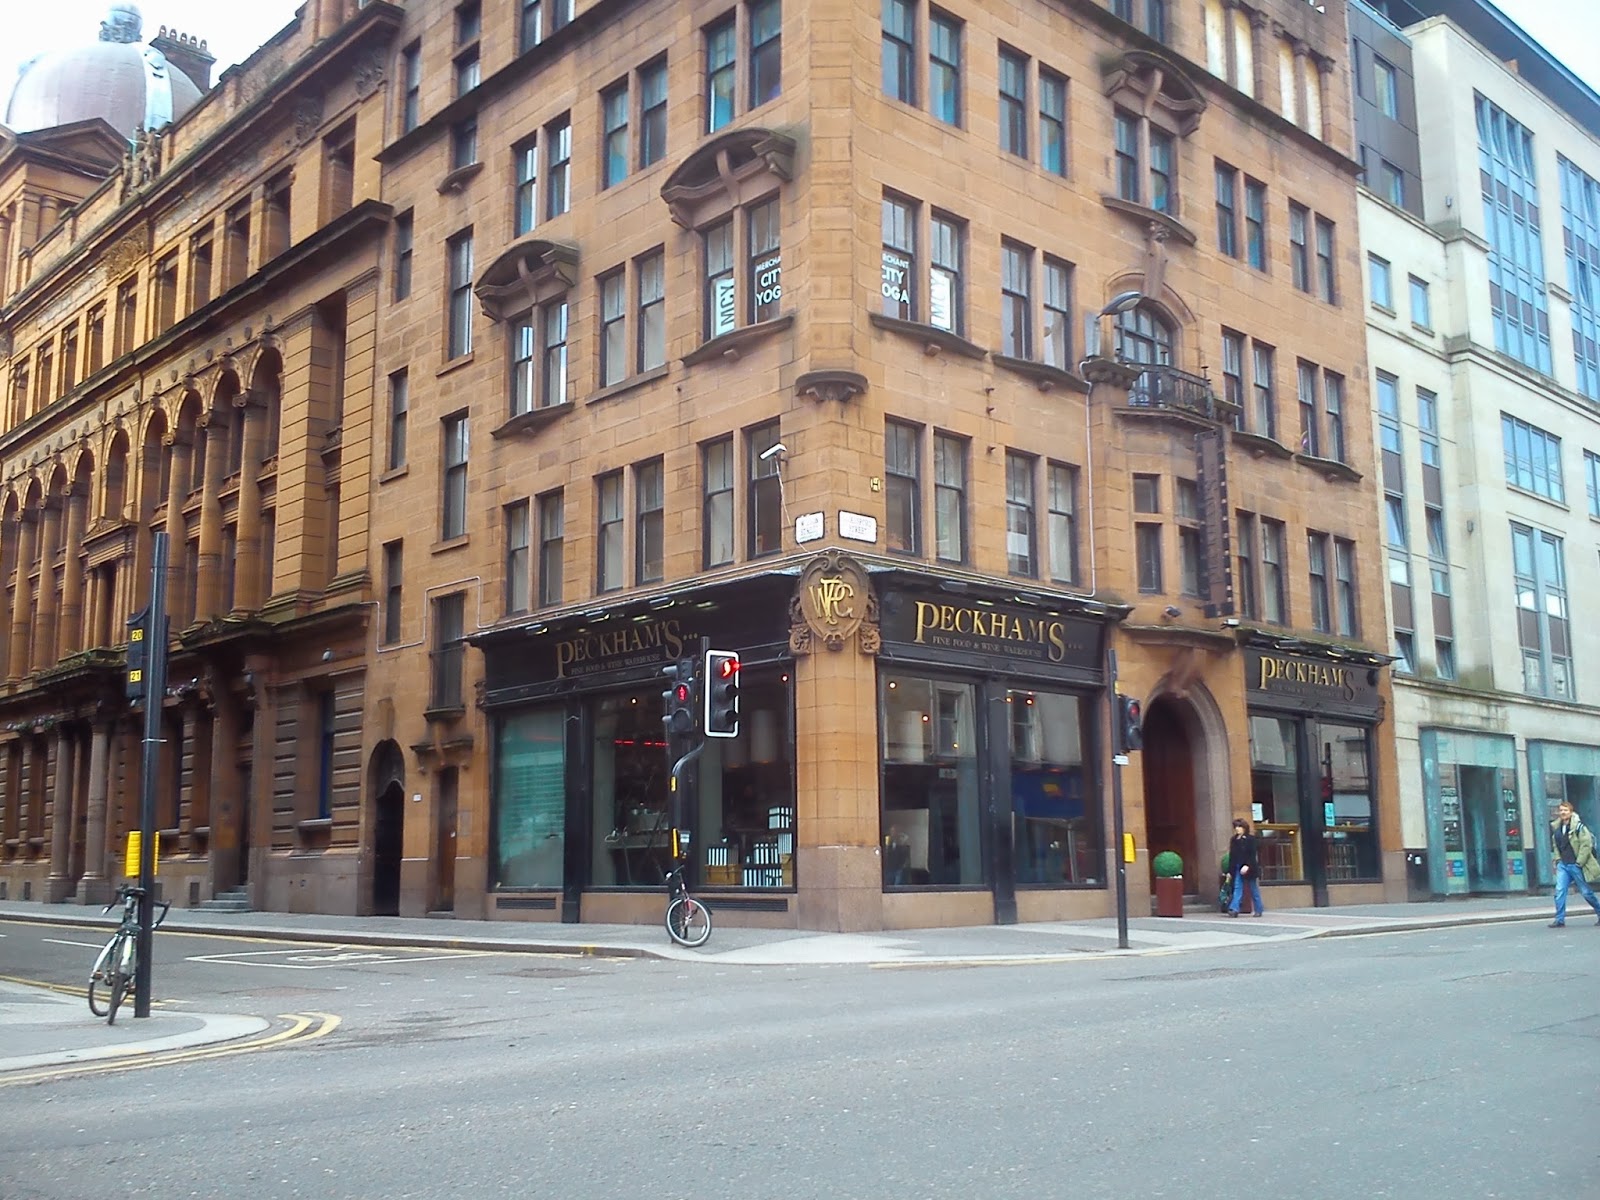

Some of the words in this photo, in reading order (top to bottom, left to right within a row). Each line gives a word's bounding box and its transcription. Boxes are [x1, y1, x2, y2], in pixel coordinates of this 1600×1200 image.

[932, 635, 951, 646] FINE
[953, 638, 971, 649] FOOD
[981, 641, 1000, 653] WINE
